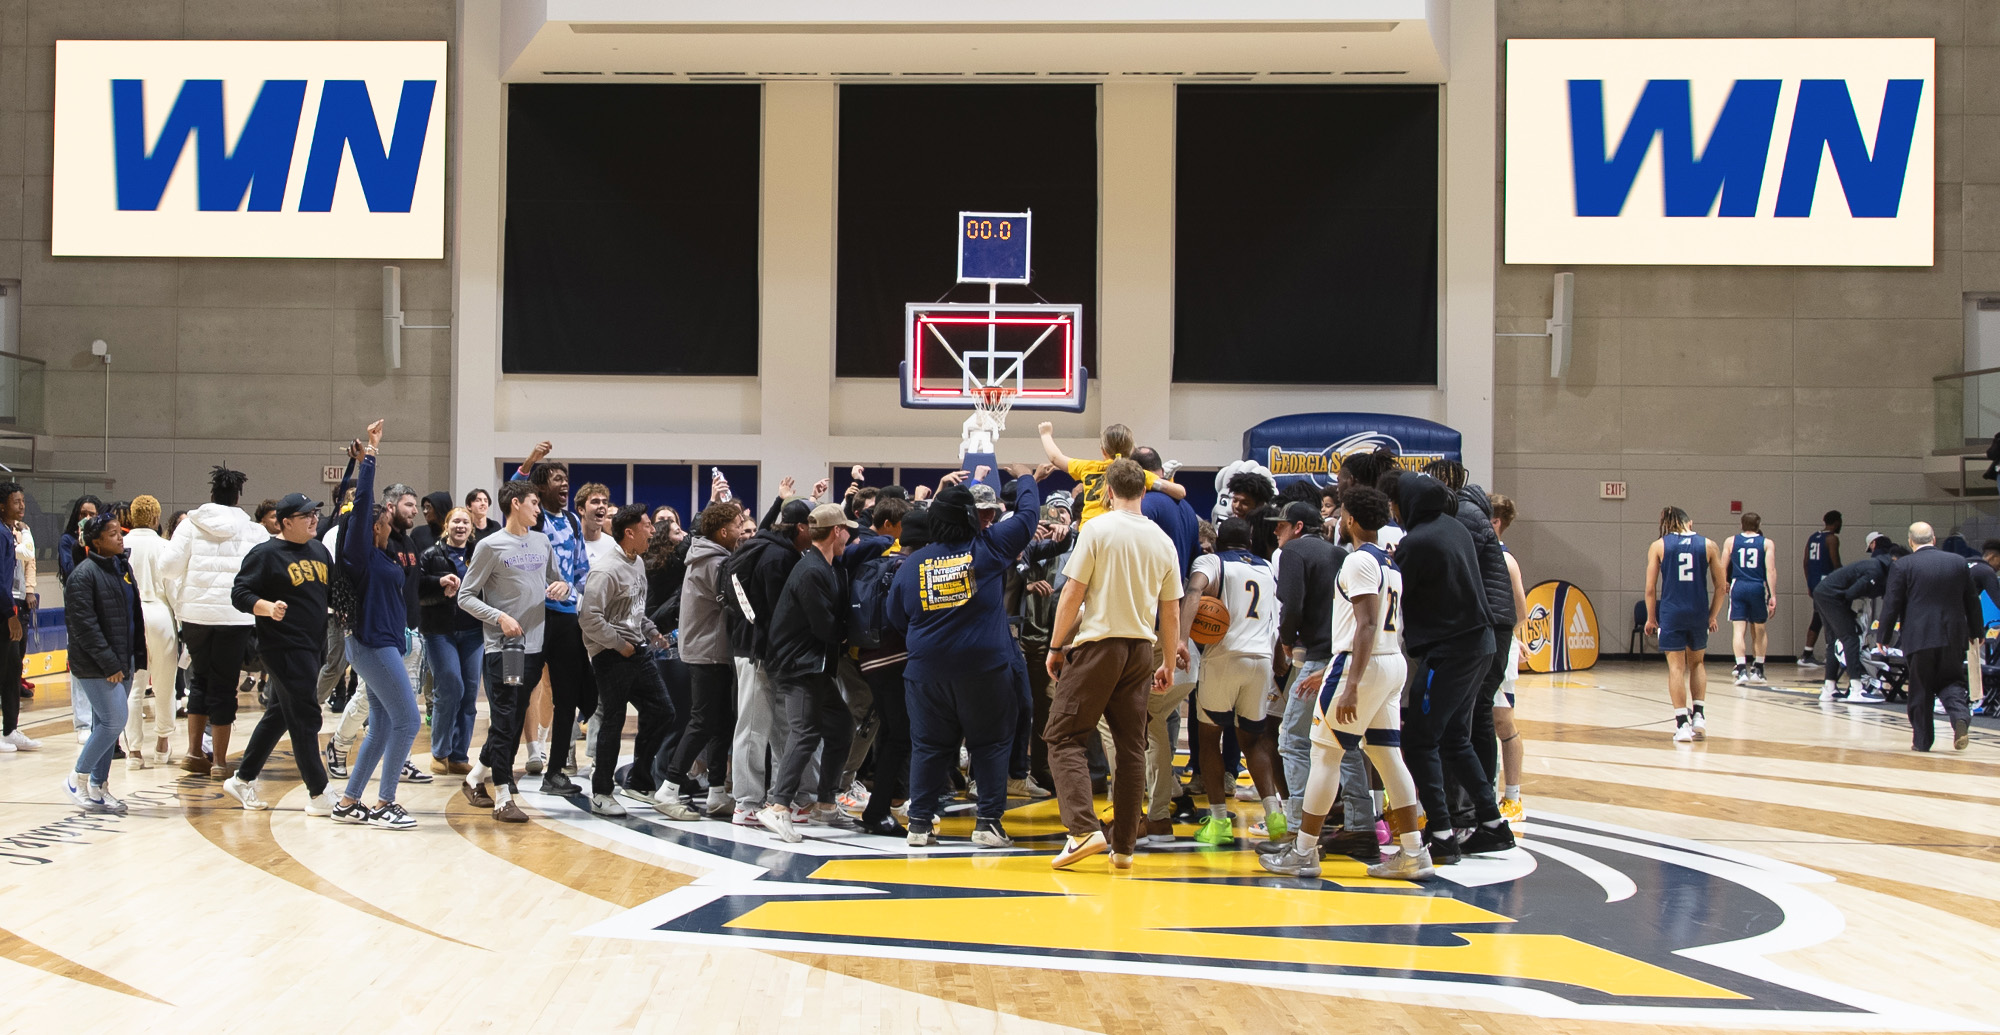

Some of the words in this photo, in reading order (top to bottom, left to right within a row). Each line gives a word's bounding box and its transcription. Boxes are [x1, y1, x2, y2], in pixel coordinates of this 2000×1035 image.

[109, 79, 437, 213] WIN
[1566, 79, 1924, 218] WIN
[967, 220, 1011, 240] 00.0
[1271, 447, 1328, 474] GEORGIA
[328, 467, 343, 479] EXIT
[1606, 483, 1622, 495] EXIT
[1738, 548, 1758, 568] 13
[1810, 542, 1820, 560] 21
[288, 559, 328, 587] GSW
[932, 571, 968, 583] INITIATIVE
[934, 563, 970, 575] INTEGRITY
[1678, 553, 1694, 581] 2
[1245, 579, 1260, 620] 2
[1525, 614, 1551, 644] GSW
[1568, 632, 1595, 649] adidas
